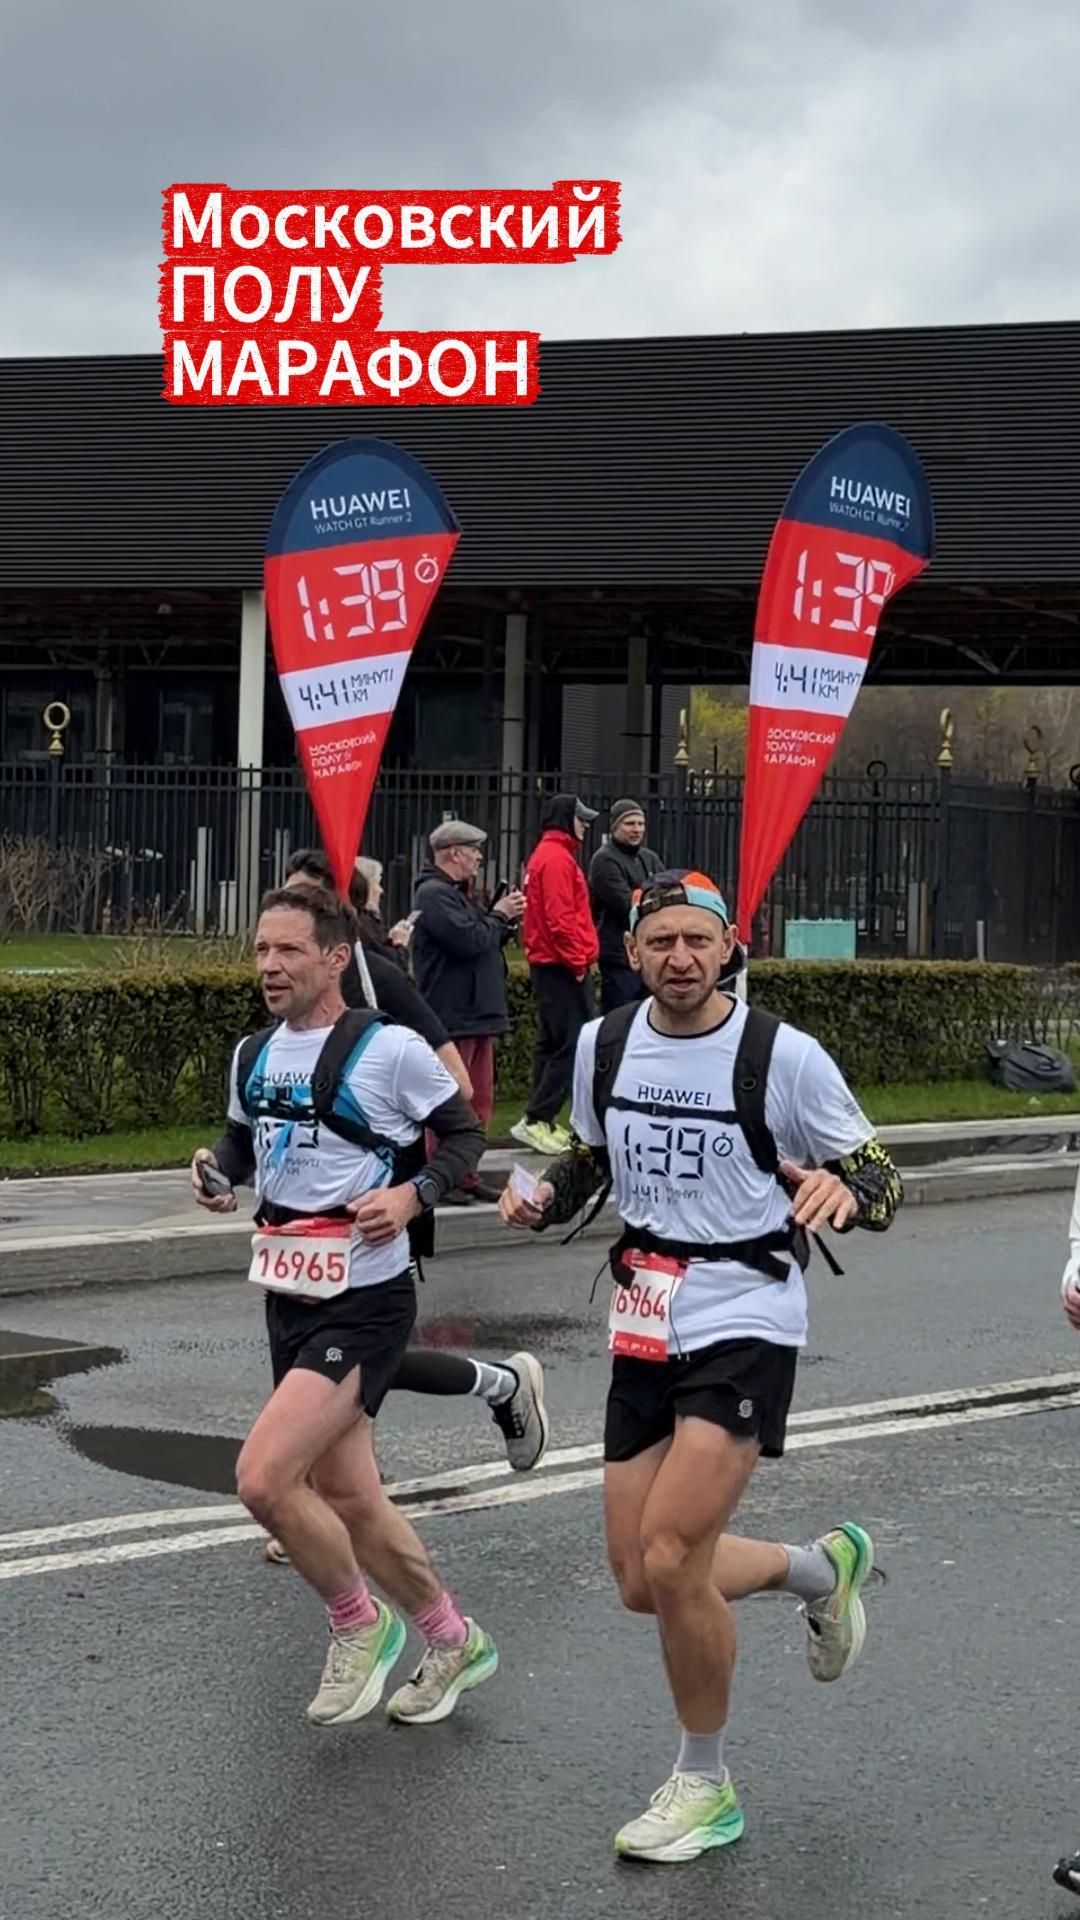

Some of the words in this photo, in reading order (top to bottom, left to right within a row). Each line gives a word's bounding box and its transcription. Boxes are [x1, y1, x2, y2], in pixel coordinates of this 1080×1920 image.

[310, 488, 411, 520] HUAWEI
[829, 476, 911, 518] HUAWEI
[829, 501, 862, 519] WATCH
[314, 519, 353, 534] WATCH
[354, 517, 368, 529] GT
[405, 511, 413, 523] 2
[297, 558, 408, 643] 1:39
[299, 678, 350, 712] 4:41
[775, 662, 818, 695] 4:41
[818, 684, 840, 700] КМ
[637, 1085, 712, 1107] HUAWEI
[624, 1122, 706, 1180] 1:39
[259, 1247, 345, 1283] 16965
